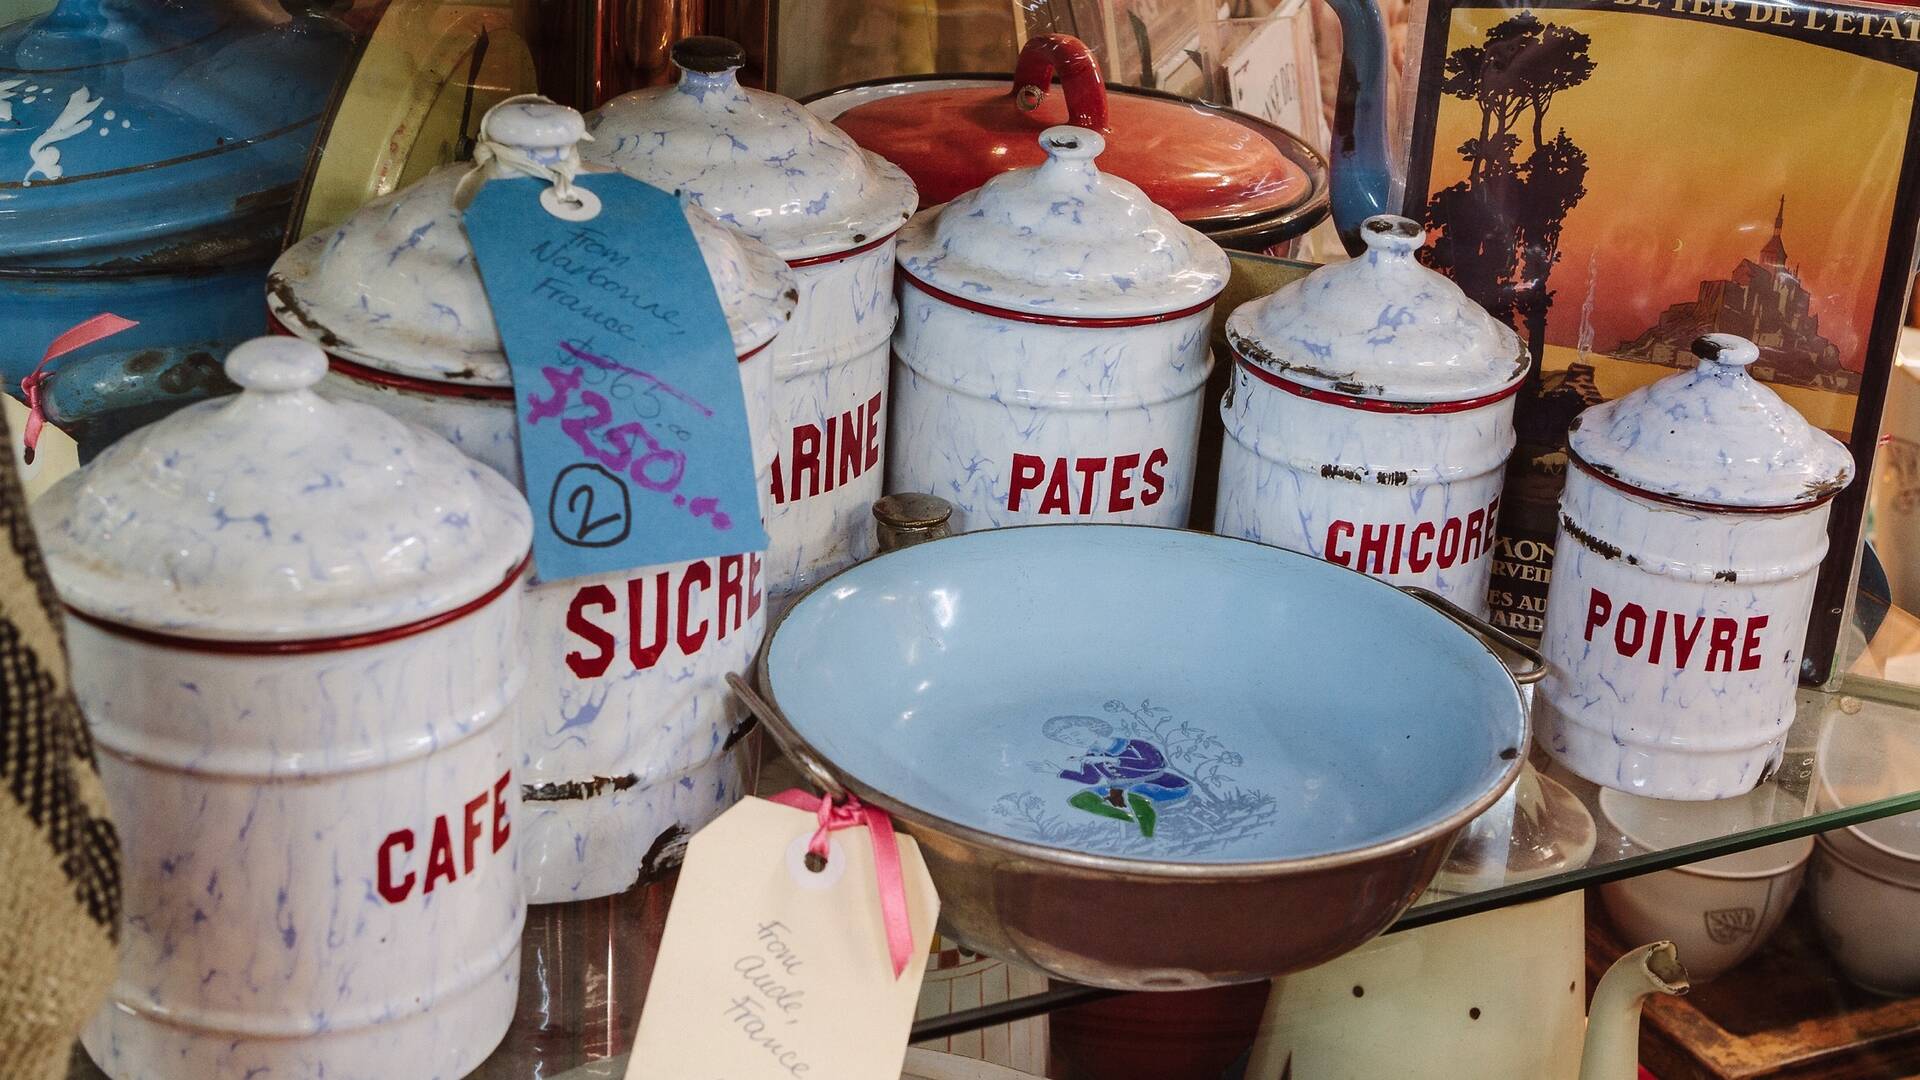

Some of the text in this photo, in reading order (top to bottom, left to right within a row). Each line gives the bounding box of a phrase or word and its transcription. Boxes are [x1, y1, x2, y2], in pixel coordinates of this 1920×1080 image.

[1745, 3, 1796, 27] DE
[566, 227, 630, 268] From
[568, 483, 622, 540] 2
[1007, 447, 1169, 516] PATES
[1324, 495, 1499, 575] CHICORE
[565, 552, 762, 680] SUCRE
[1584, 587, 1770, 673] POIVRE
[377, 768, 512, 905] CAFE
[758, 920, 803, 975] From
[723, 995, 810, 1080] France
